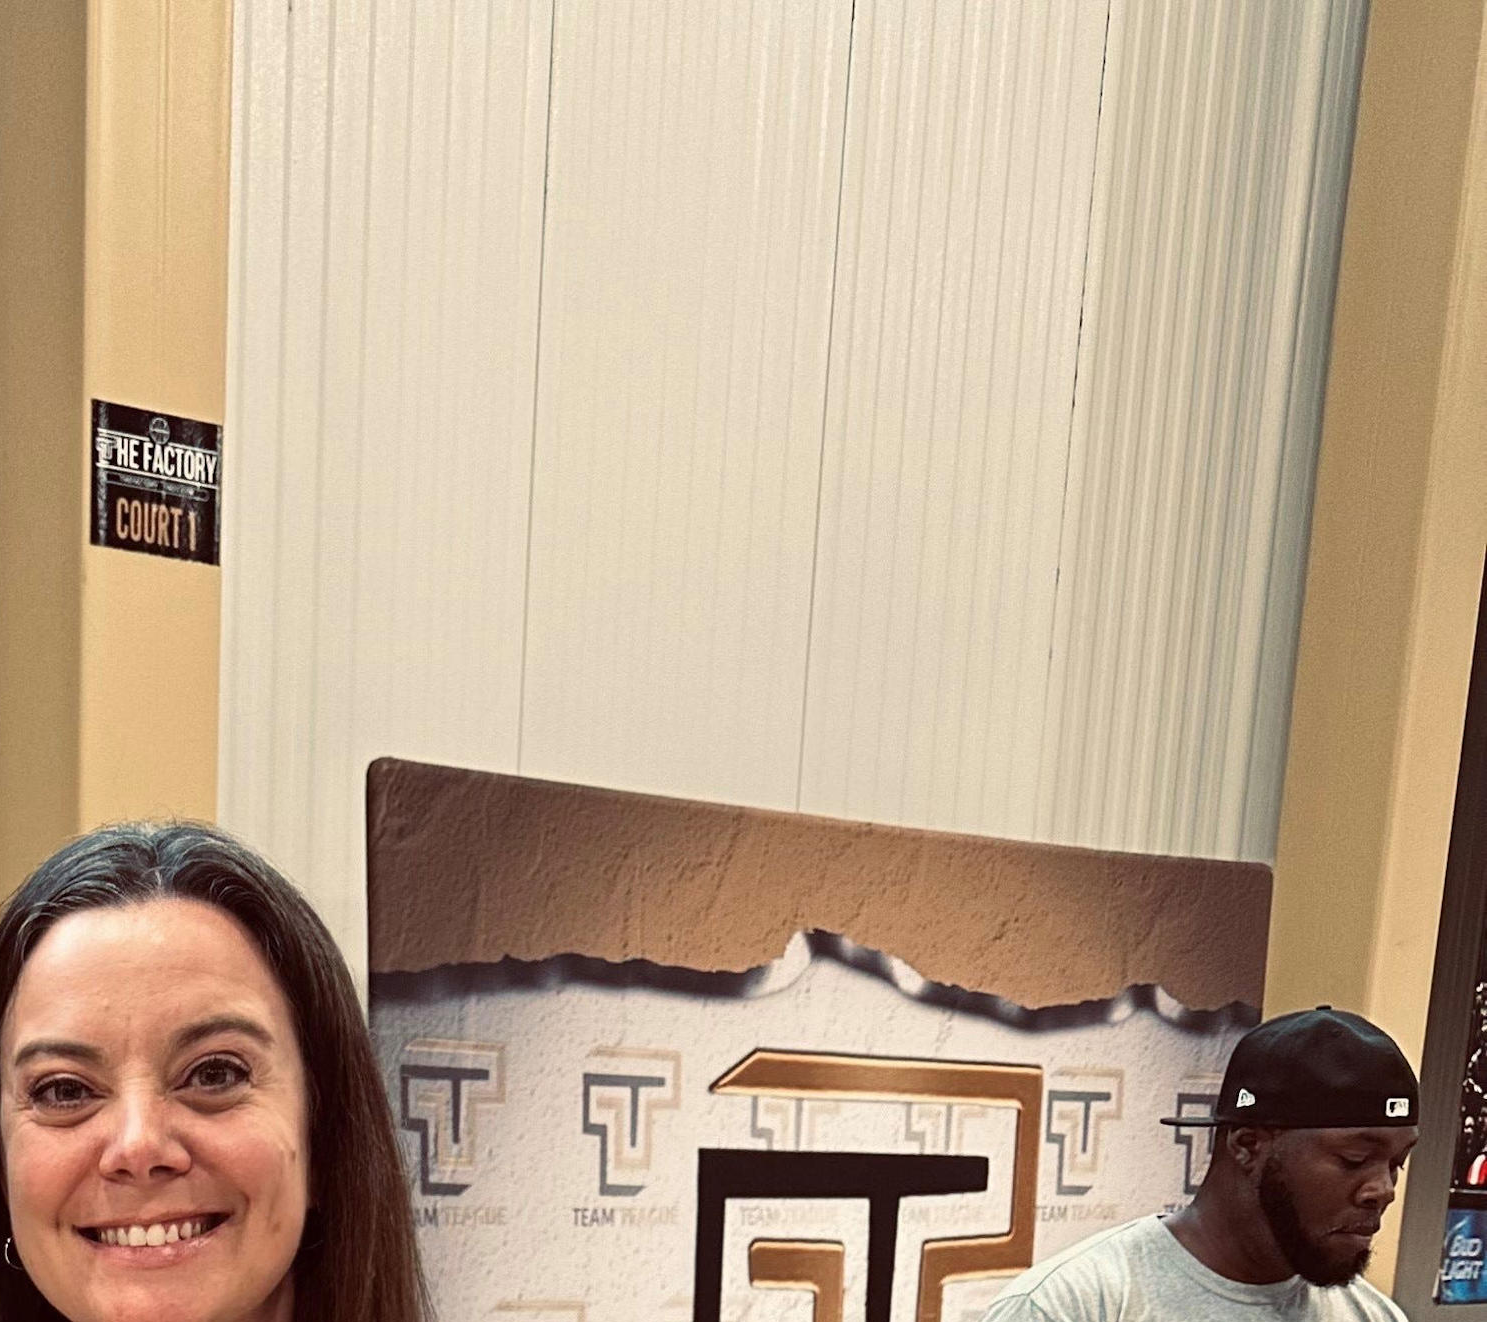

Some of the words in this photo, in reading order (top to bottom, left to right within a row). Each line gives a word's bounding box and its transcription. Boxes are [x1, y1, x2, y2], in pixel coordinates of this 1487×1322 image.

[144, 443, 218, 484] FACTORY
[116, 498, 183, 549] COURT
[187, 510, 197, 552] 1
[573, 1207, 613, 1228] TEAM
[1036, 1205, 1067, 1223] TEAM
[1449, 1234, 1483, 1257] BUD
[1441, 1258, 1484, 1281] LIGHT
